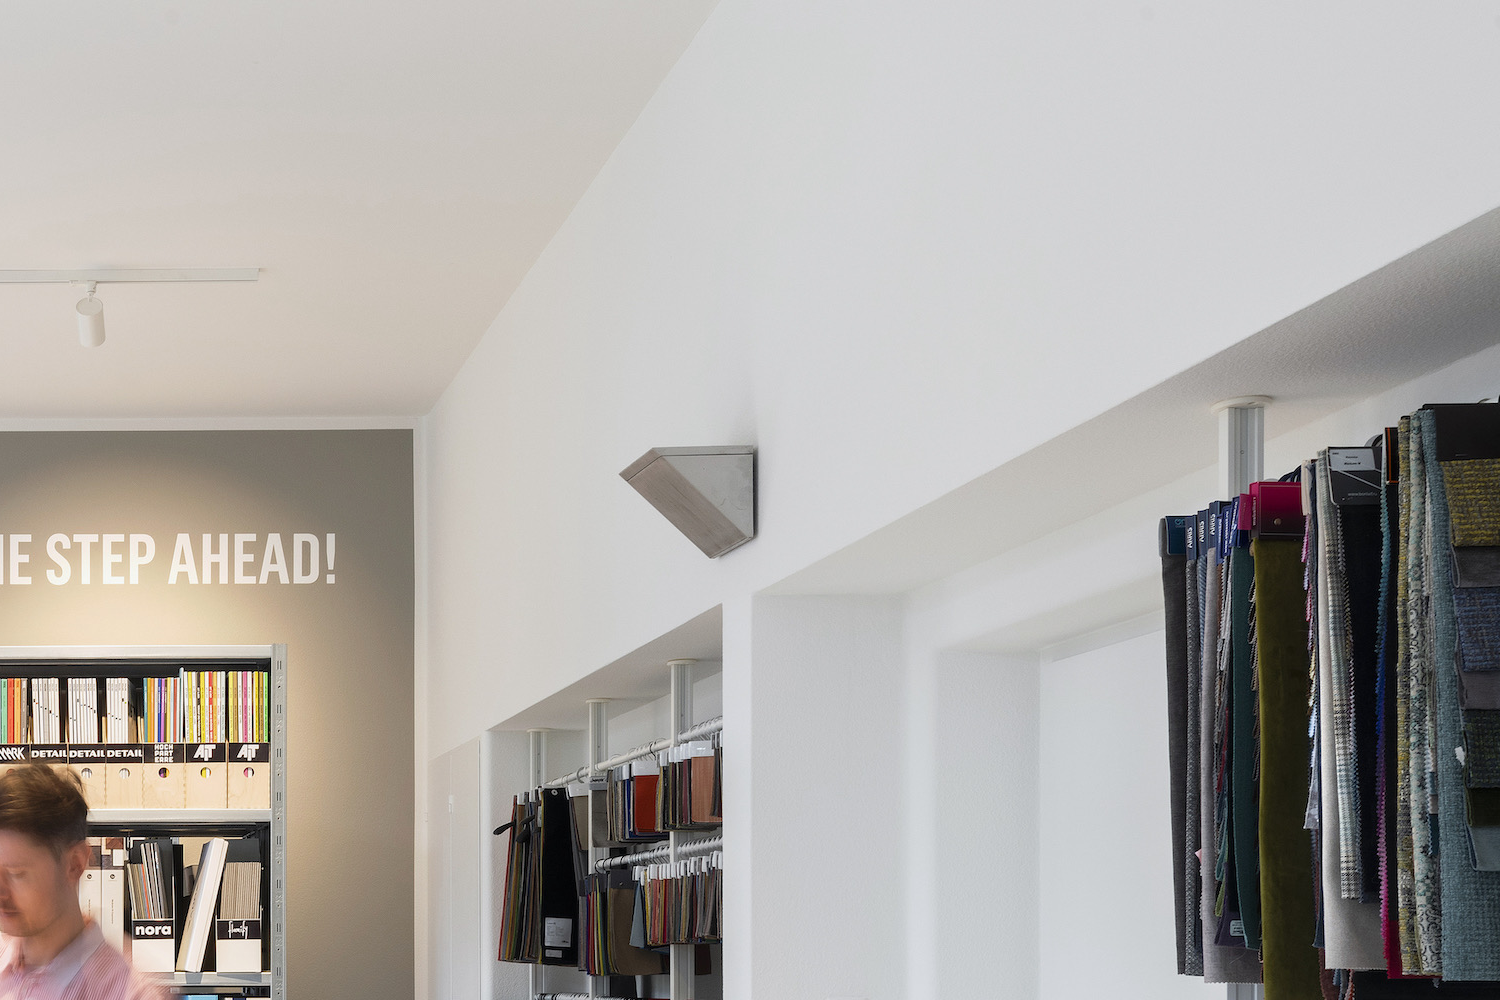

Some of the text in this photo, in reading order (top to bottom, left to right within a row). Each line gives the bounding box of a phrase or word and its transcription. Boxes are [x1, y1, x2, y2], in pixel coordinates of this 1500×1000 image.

[46, 532, 156, 586] STEP
[167, 532, 337, 586] AHEAD!
[31, 750, 67, 758] DETAIL
[69, 750, 106, 758] DETAIL
[106, 750, 143, 758] DETAIL
[134, 924, 172, 937] nora
